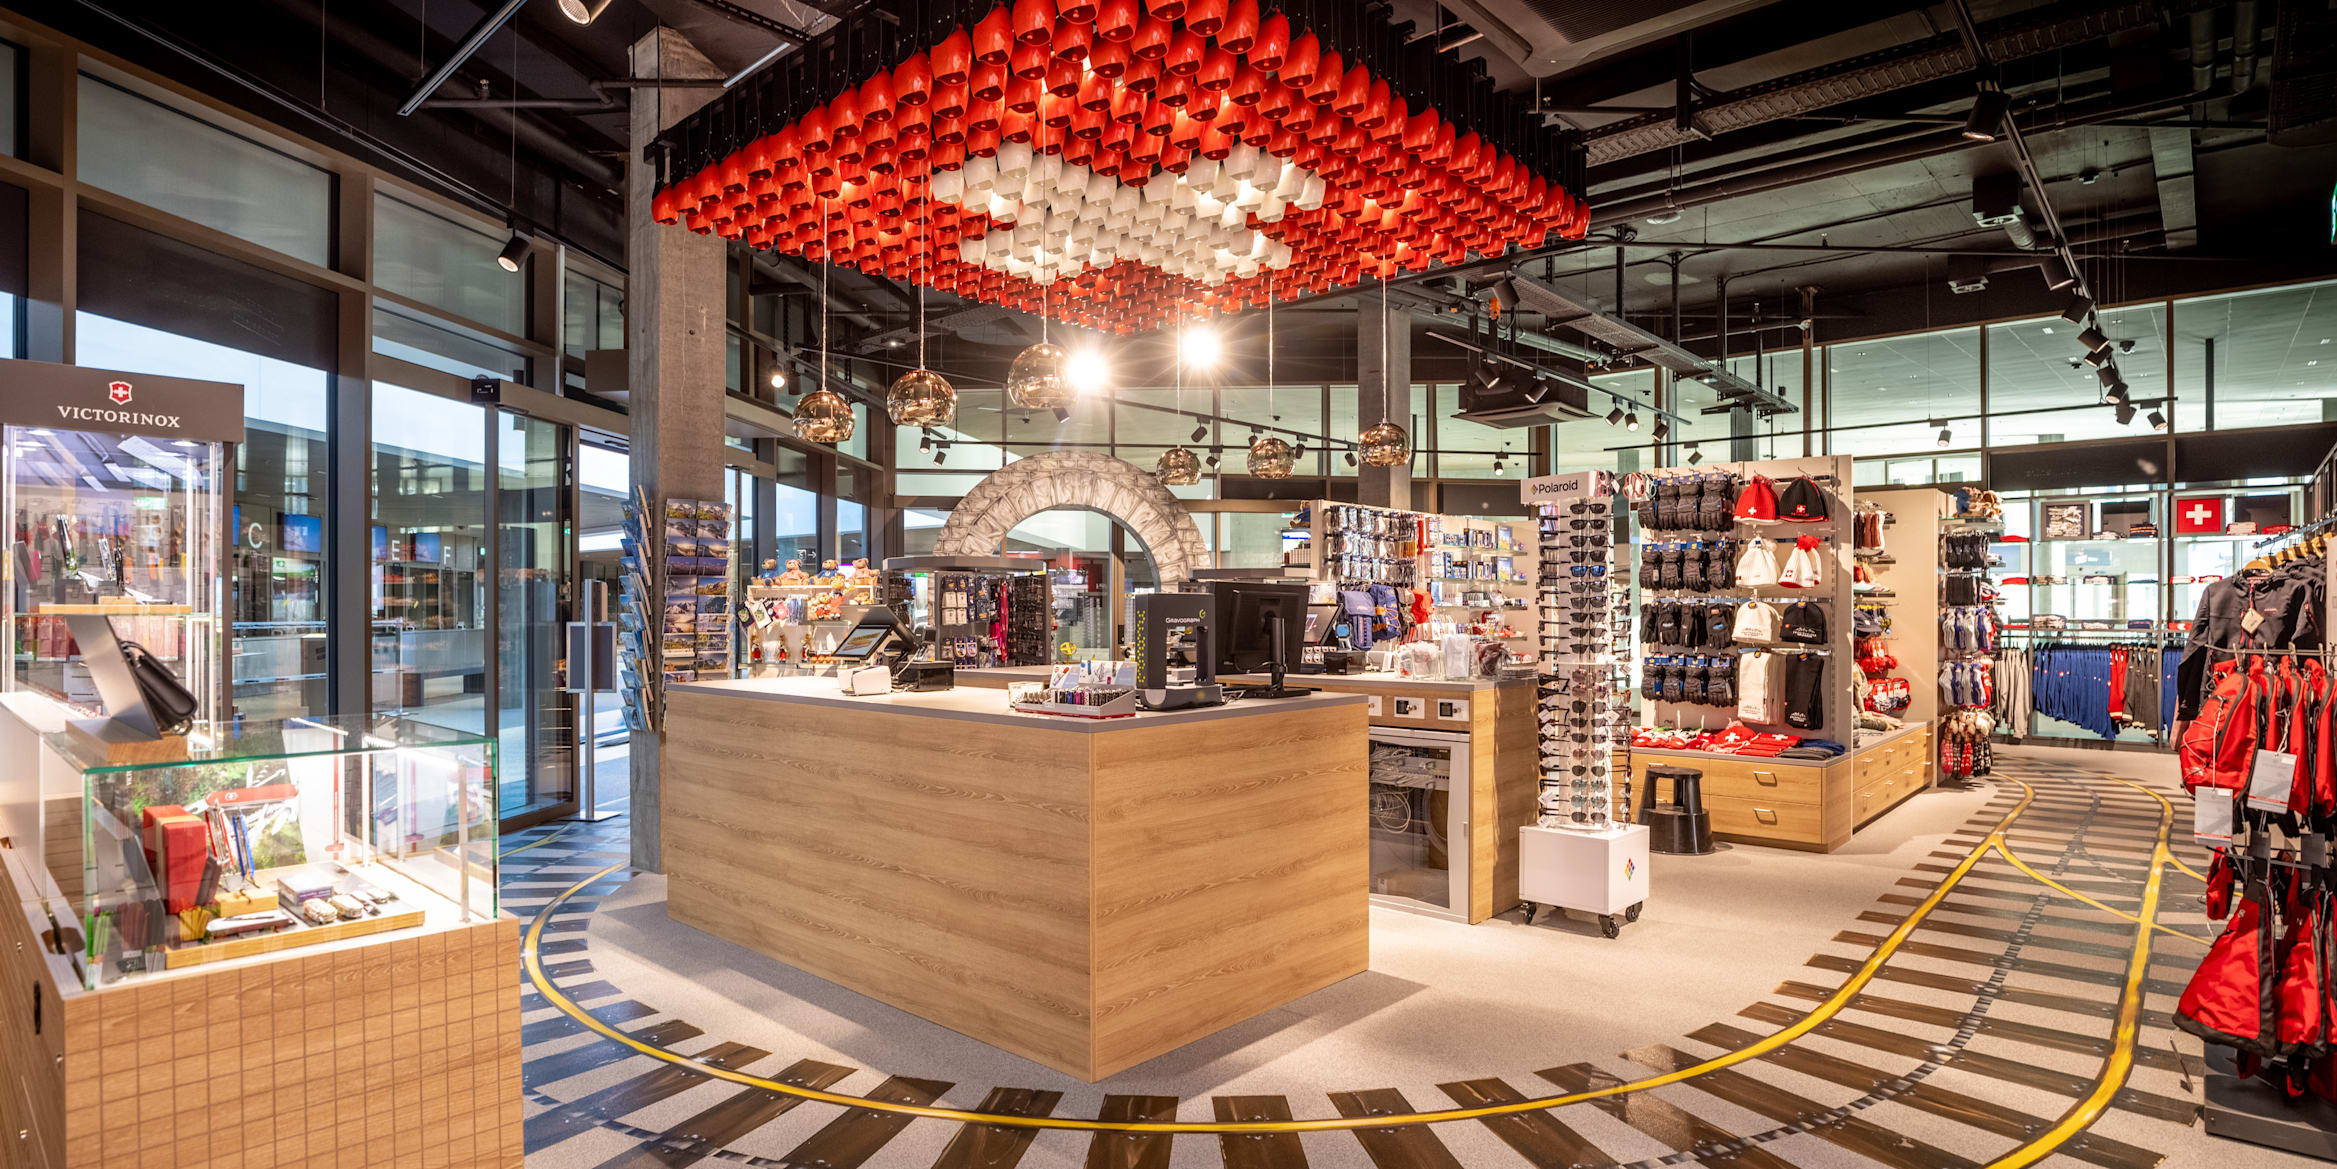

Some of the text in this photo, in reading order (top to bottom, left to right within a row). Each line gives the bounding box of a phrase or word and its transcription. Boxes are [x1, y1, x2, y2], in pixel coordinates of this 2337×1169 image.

[57, 405, 180, 428] VICTORINOX
[1538, 479, 1578, 495] Polaroid
[248, 522, 263, 549] C
[391, 540, 401, 561] E
[443, 546, 451, 565] F
